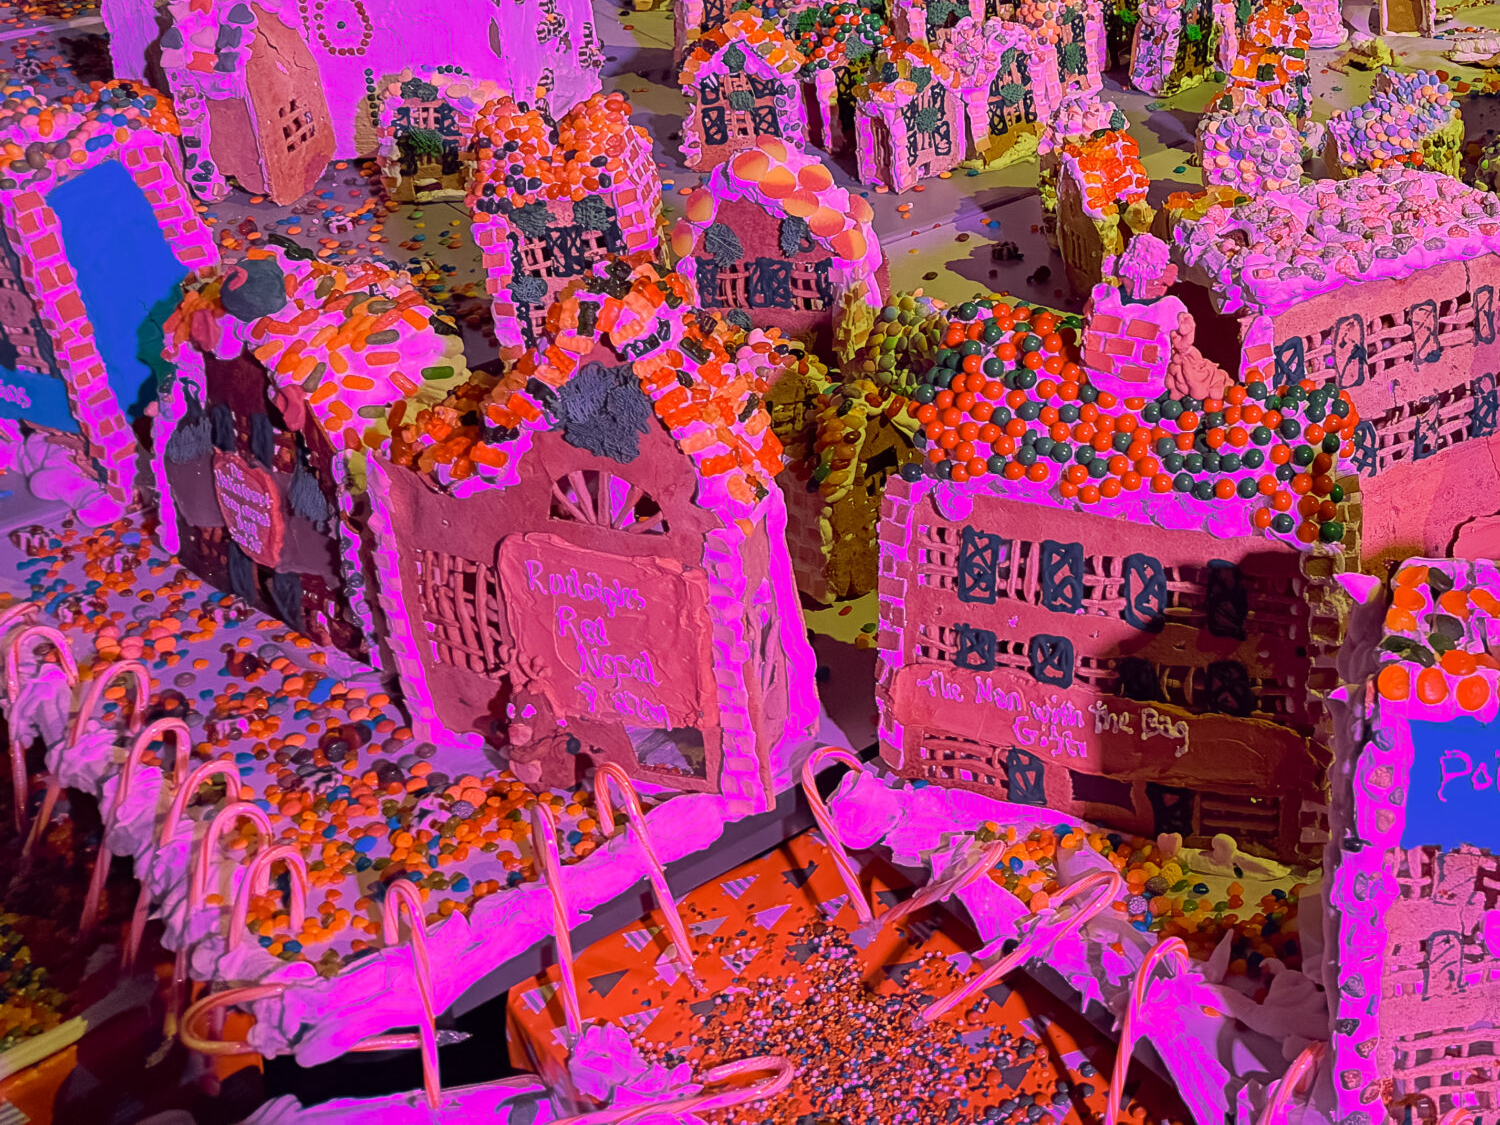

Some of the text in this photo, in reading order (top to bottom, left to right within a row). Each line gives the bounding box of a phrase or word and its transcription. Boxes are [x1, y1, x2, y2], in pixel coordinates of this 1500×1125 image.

[917, 670, 964, 703] The
[975, 676, 1022, 711] Man
[1141, 707, 1190, 758] Bag
